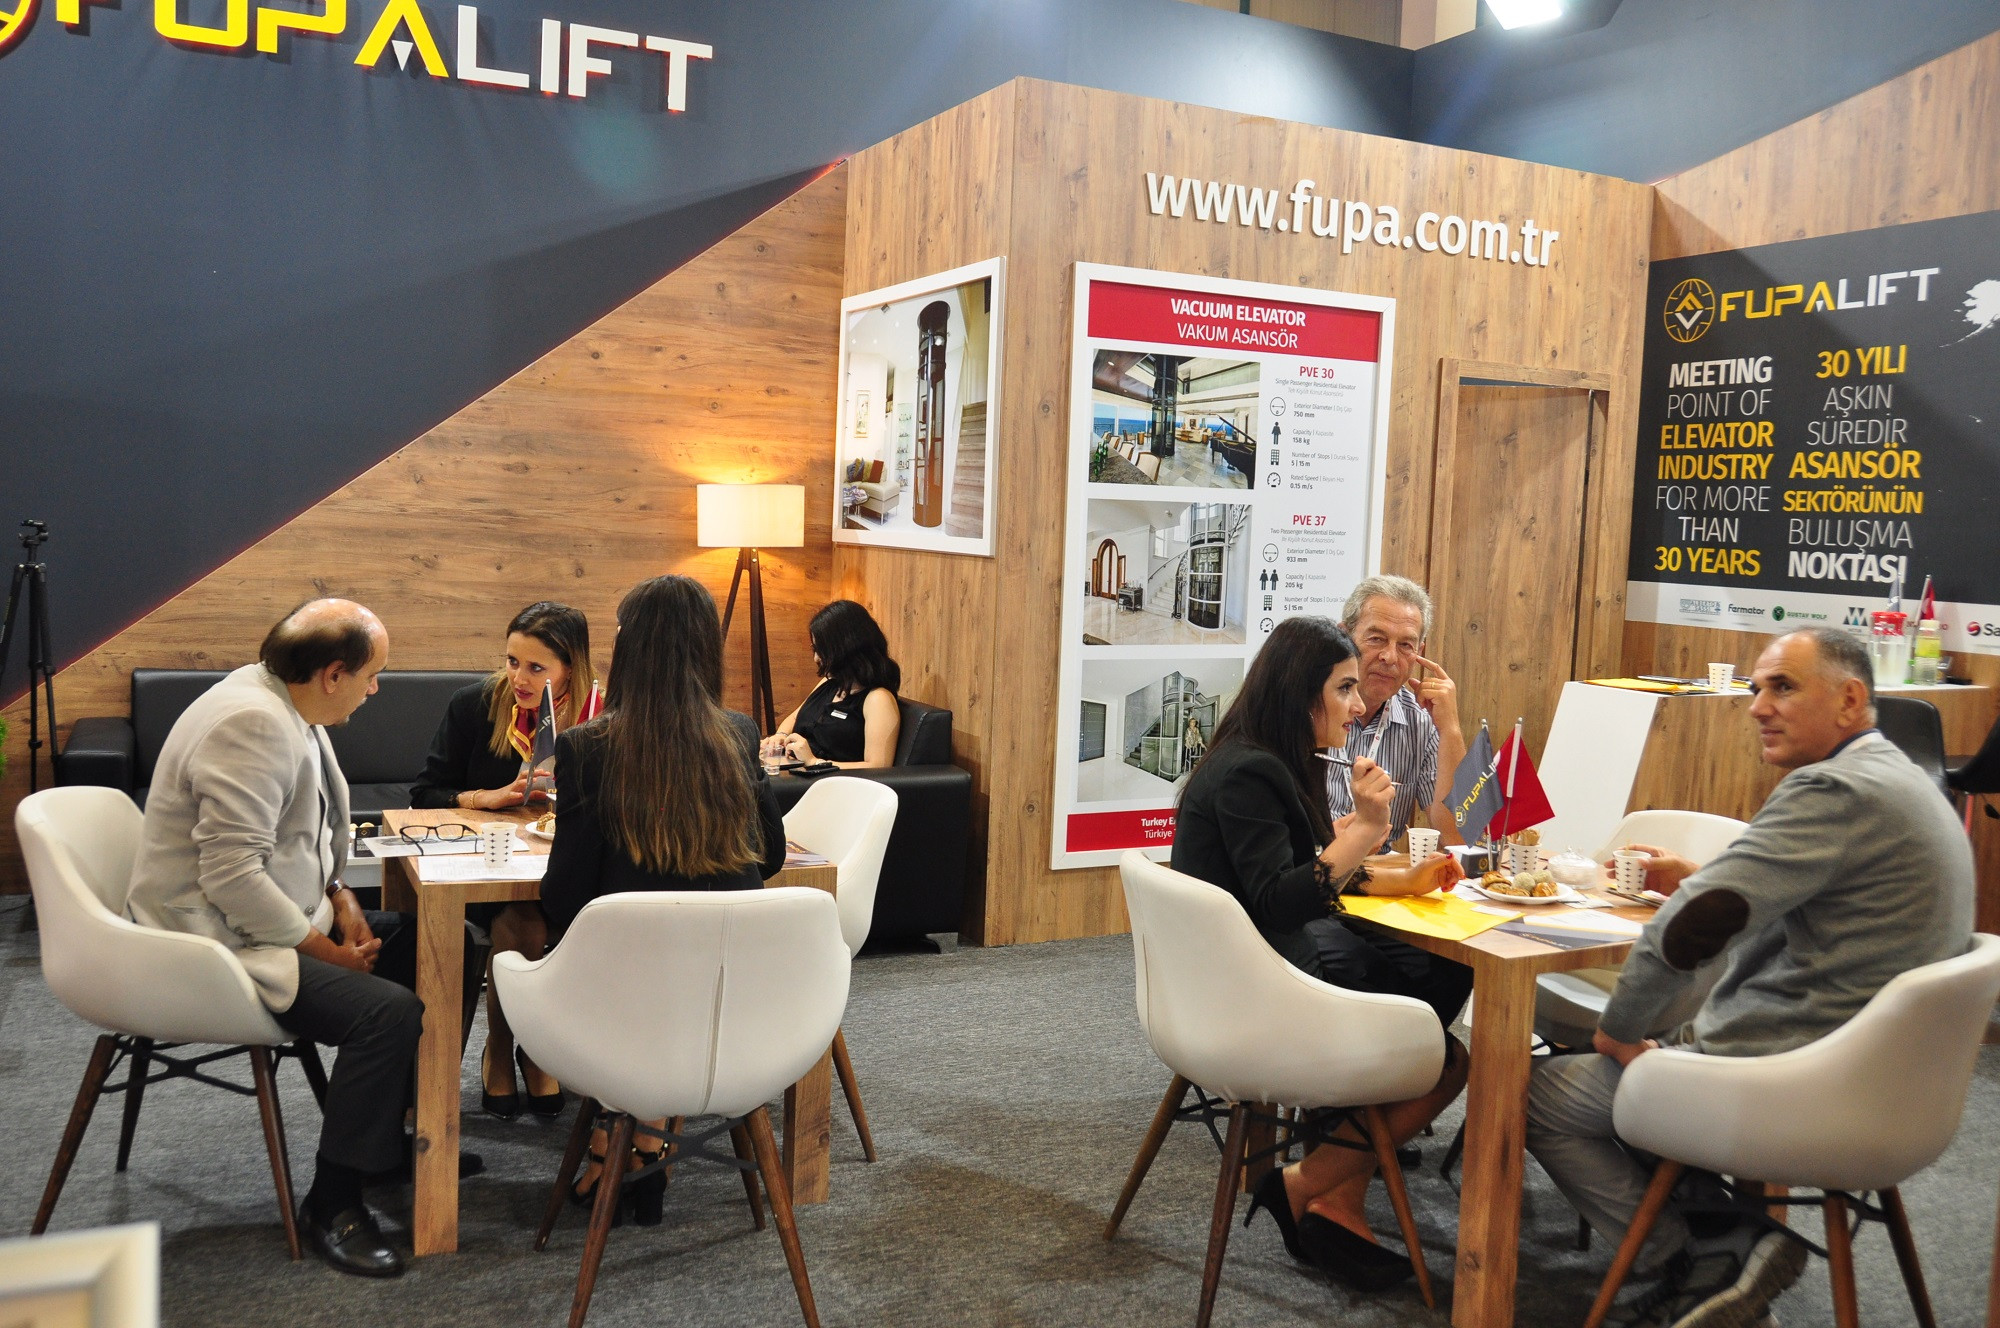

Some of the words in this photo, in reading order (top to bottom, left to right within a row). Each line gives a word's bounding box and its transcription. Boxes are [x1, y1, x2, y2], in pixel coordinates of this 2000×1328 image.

[1145, 171, 1560, 267] www.fupa.com.tr
[1720, 267, 1940, 322] FUPALIFT
[1171, 298, 1233, 320] VACUUM
[1236, 305, 1306, 327] ELEVATOR
[1177, 322, 1228, 343] VAKUM
[1232, 328, 1298, 349] ASANSÖR
[1300, 366, 1319, 378] PVE
[1321, 368, 1334, 379] 30
[1669, 356, 1773, 388] MEETING
[1816, 350, 1851, 378] 30
[1856, 345, 1907, 375] YILI
[1290, 380, 1313, 388] Passenger
[1312, 403, 1332, 411] Diameter
[1667, 391, 1735, 419] POINT
[1740, 388, 1773, 416] OF
[1823, 384, 1893, 415] AŞKIN
[1293, 428, 1312, 436] Capacity
[1303, 437, 1310, 445] kg
[1661, 421, 1774, 450] ELEVATOR
[1806, 413, 1908, 446] SÜREDİR
[1658, 453, 1774, 480] INDUSTRY
[1788, 442, 1922, 479] ASANSÖR
[1656, 486, 1697, 511] FOR
[1703, 486, 1771, 512] MORE
[1782, 484, 1923, 514] SEKTÖRÜNÜN
[1293, 515, 1312, 526] PVE
[1314, 516, 1327, 526] 37
[1678, 516, 1739, 543] THAN
[1788, 518, 1913, 554] BULUŞMA
[1654, 546, 1682, 571] 30
[1687, 547, 1761, 577] YEARS
[1788, 551, 1907, 584] NOKTASI
[1728, 603, 1765, 615] Fermator
[1786, 611, 1809, 619] GUSTAV
[1463, 762, 1497, 811] FUPALIF
[1141, 817, 1168, 828] Turkey
[1144, 829, 1172, 840] Türkiye
